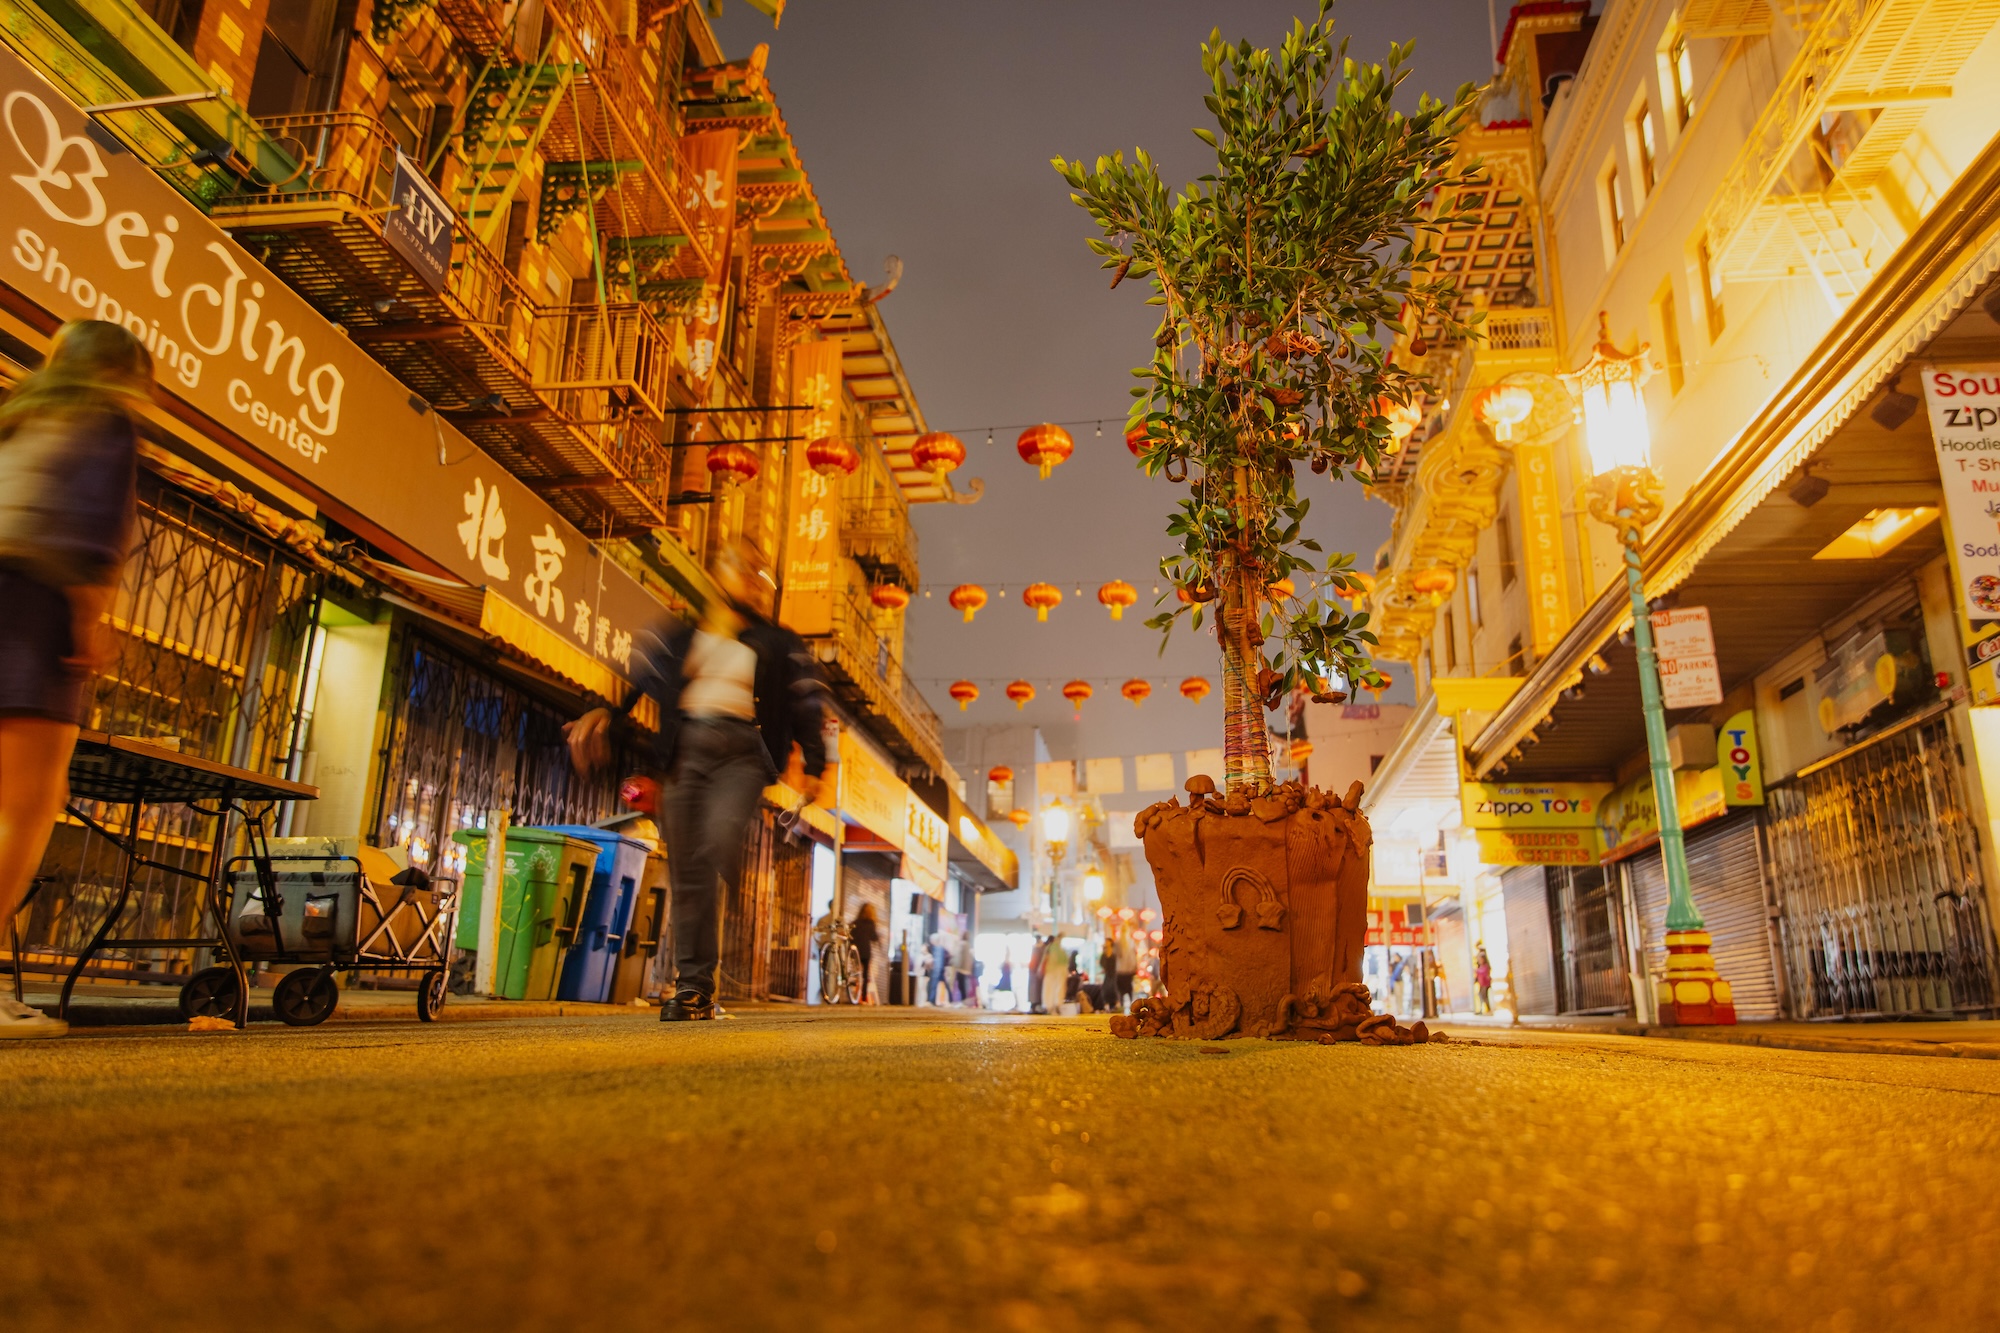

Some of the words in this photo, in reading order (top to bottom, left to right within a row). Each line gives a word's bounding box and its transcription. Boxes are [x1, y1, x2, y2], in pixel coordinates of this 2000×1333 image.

[393, 217, 444, 275] 415.772.8800
[12, 228, 203, 389] Shopping
[227, 378, 328, 464] Center
[1933, 373, 2000, 397] Sou
[1529, 457, 1552, 549] GIFTS
[1963, 543, 2000, 557] Sod
[1653, 613, 1669, 626] NO
[1670, 612, 1705, 624] STOPPING
[1660, 660, 1676, 674] NO
[1678, 659, 1713, 671] PARKING
[1727, 730, 1753, 801] TOYS
[1541, 799, 1591, 814] TOYS
[1500, 832, 1580, 847] SHIRTS
[1492, 848, 1590, 864] JACKETS
